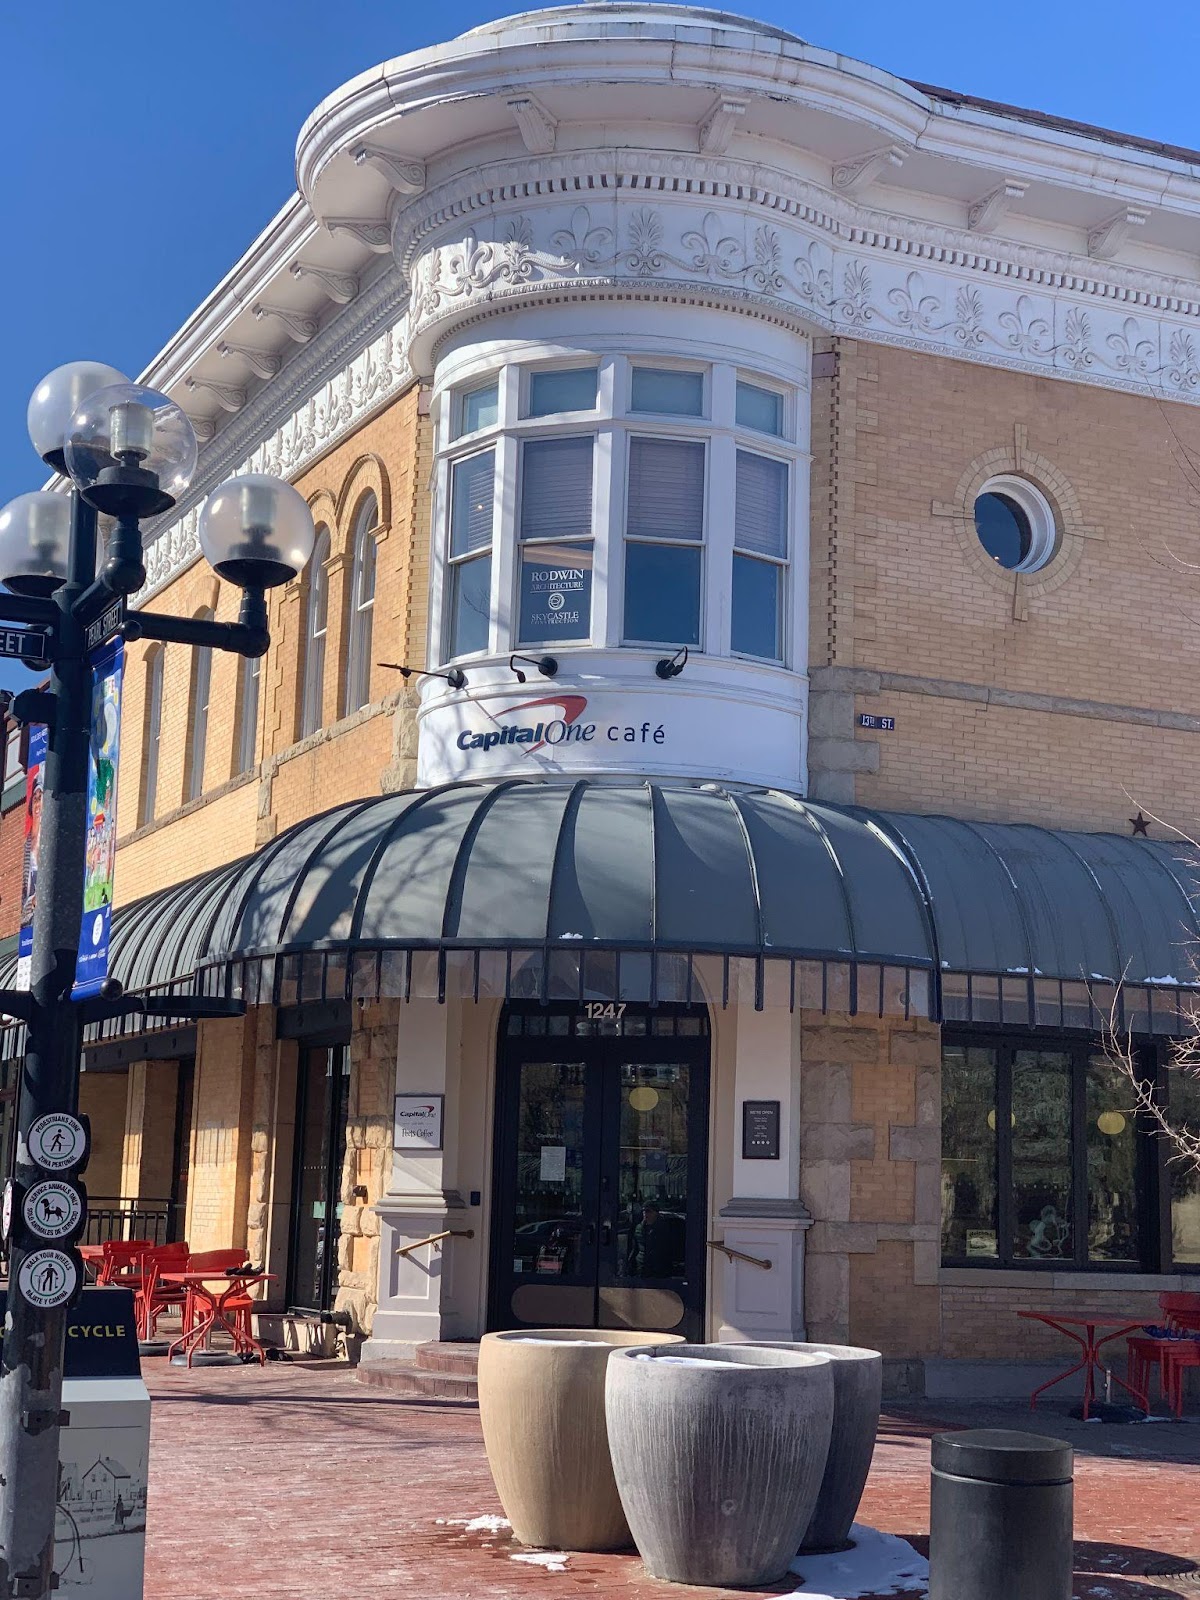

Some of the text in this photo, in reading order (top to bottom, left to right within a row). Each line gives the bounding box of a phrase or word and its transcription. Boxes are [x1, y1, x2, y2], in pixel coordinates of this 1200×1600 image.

[531, 569, 584, 582] RODWIN
[531, 581, 584, 590] ARCHITECTURE
[103, 605, 119, 636] STREET
[531, 611, 579, 621] SKYCASTLE
[607, 722, 666, 745] café
[584, 1003, 627, 1019] 1247
[68, 1120, 81, 1132] ZONE
[38, 1155, 51, 1167] ZONA
[30, 1183, 79, 1206] SERVICE ANIMALS ONLY
[27, 1207, 35, 1221] SOLO
[31, 1220, 54, 1236] ANIMALES
[62, 1210, 79, 1233] SERVICIO
[25, 1255, 40, 1270] WALK
[54, 1253, 73, 1271] WHEELS
[49, 1290, 68, 1304] CAMINA
